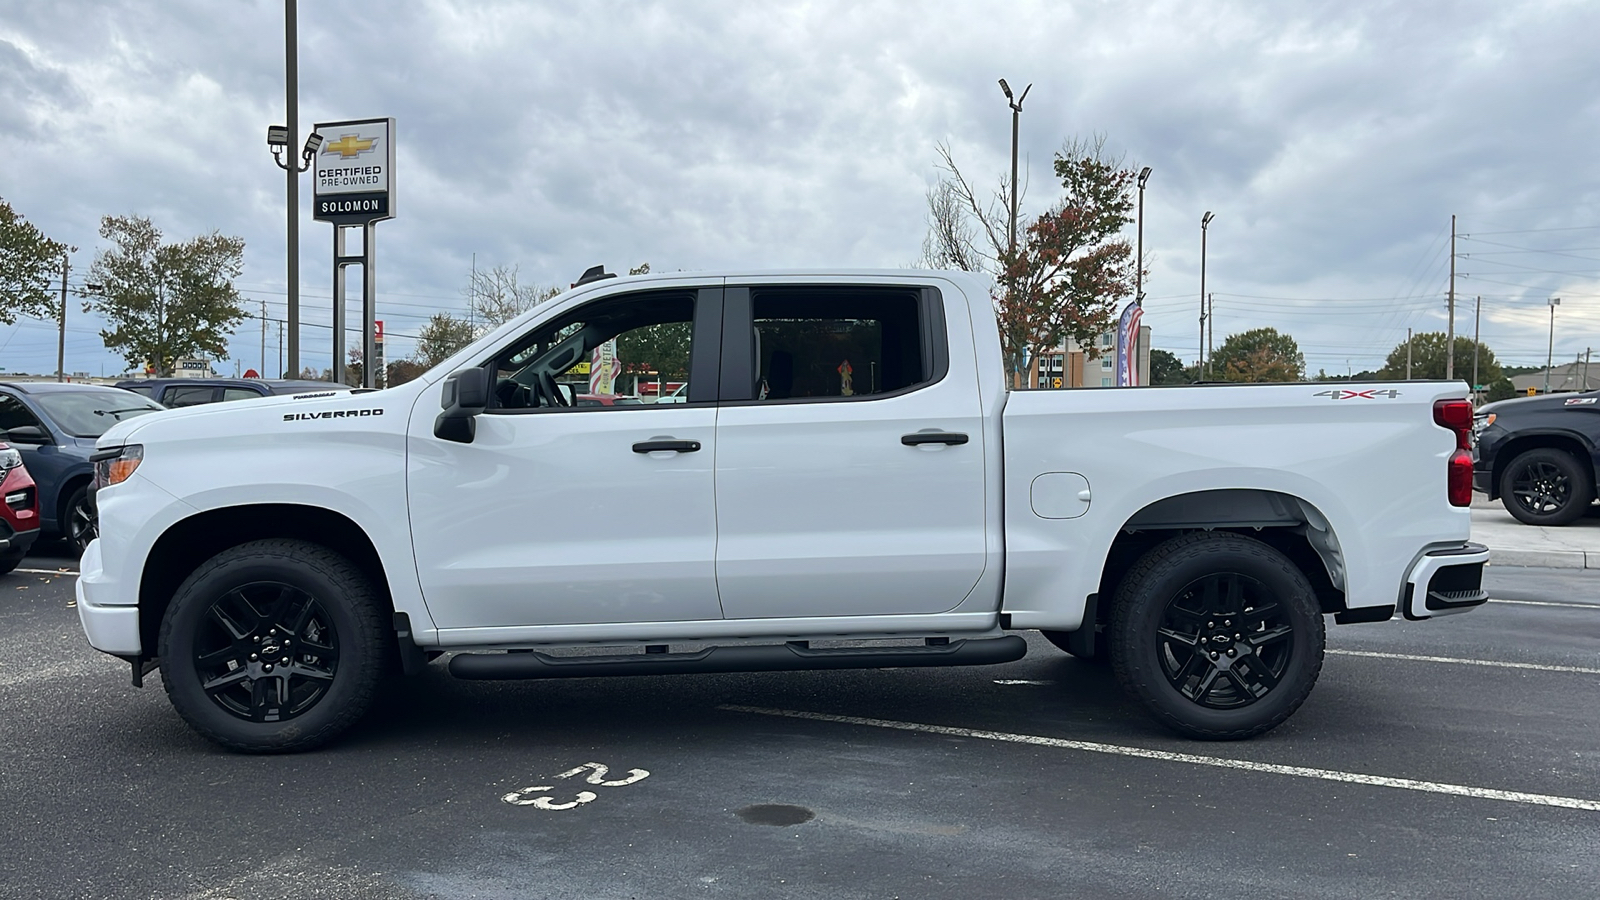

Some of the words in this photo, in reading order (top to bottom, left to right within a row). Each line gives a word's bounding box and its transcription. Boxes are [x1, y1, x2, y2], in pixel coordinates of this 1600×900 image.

[318, 166, 382, 178] CERTIFIED
[321, 175, 379, 187] PRE-OWNED
[321, 200, 379, 213] SOLOMON
[602, 340, 612, 366] VETER
[283, 408, 384, 421] SILVERADO
